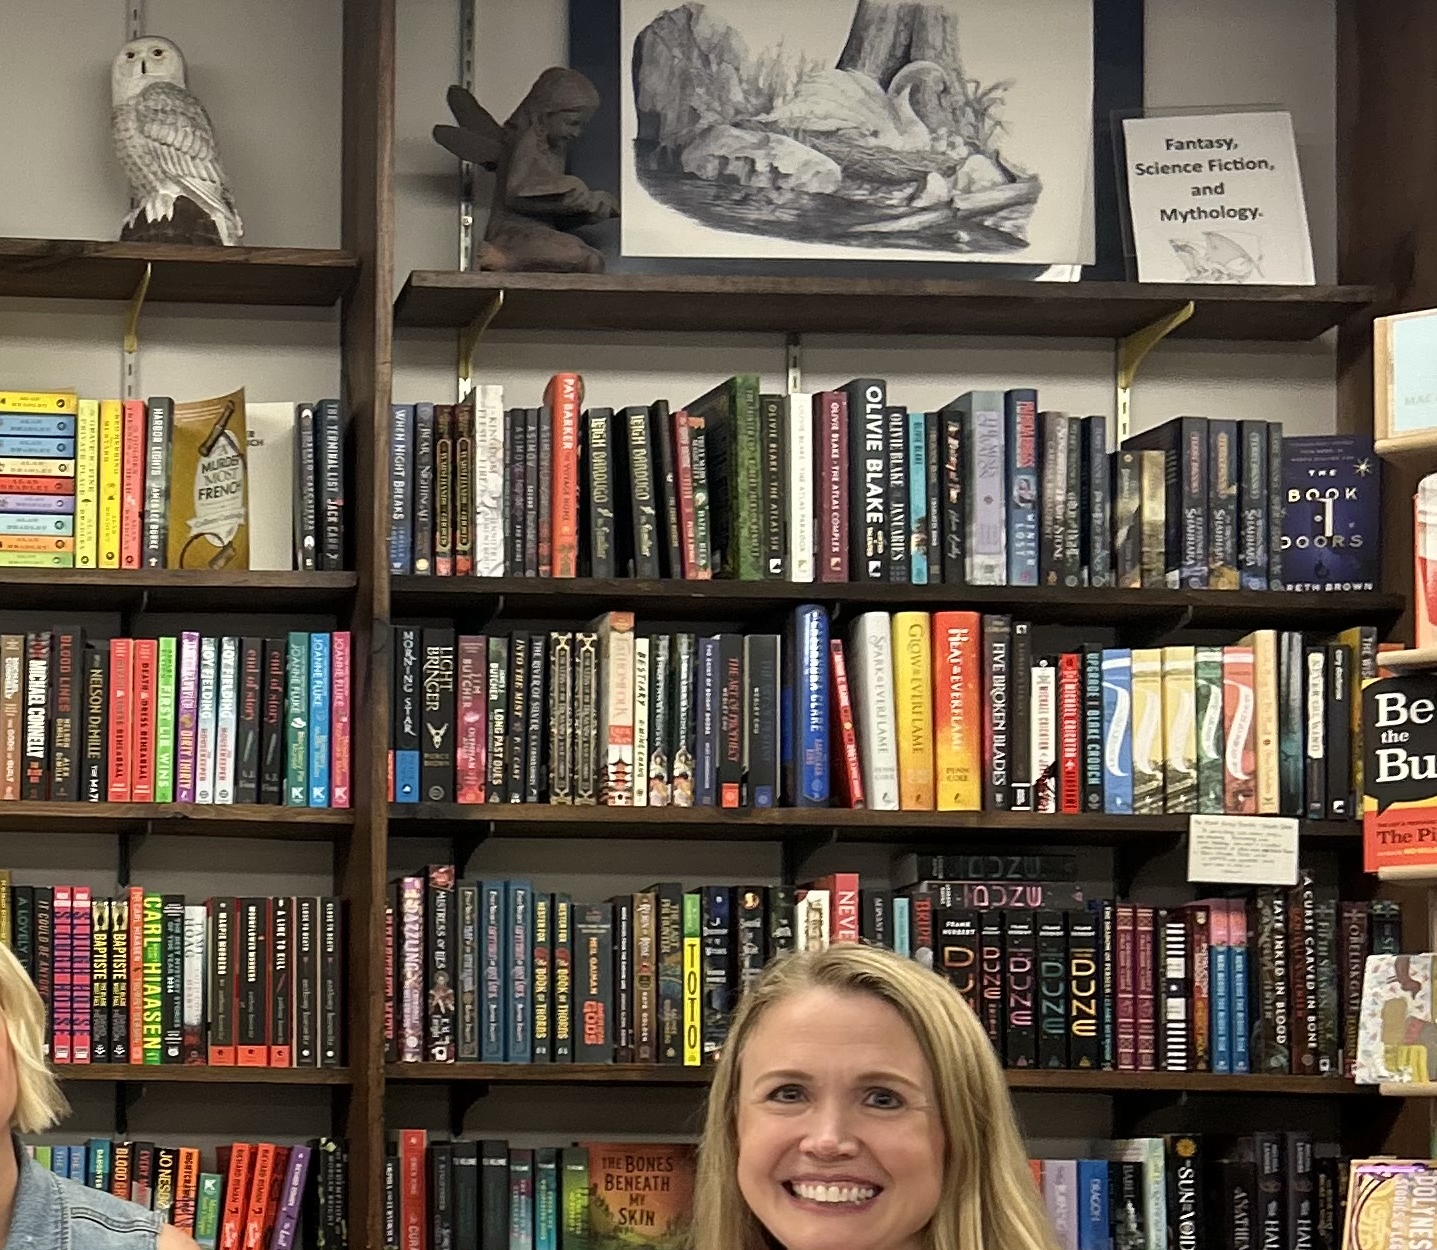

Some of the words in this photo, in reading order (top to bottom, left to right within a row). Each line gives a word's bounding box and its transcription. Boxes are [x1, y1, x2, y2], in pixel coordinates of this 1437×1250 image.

[1165, 138, 1238, 151] Fantasy,
[1135, 161, 1202, 176] Science
[1208, 158, 1275, 172] Fiction,
[1191, 182, 1224, 196] and
[1160, 206, 1263, 223] Mythology.
[562, 378, 574, 399] PAT
[393, 410, 405, 441] WHEN
[561, 402, 574, 449] BARKER
[865, 386, 883, 455] OLIVIE
[888, 413, 903, 454] OLIVIE
[392, 445, 405, 477] NIGHT
[889, 457, 904, 487] BLAKE
[1308, 469, 1337, 477] THE
[392, 480, 406, 519] BREAKS
[865, 459, 883, 524] BLAKE
[1288, 488, 1357, 502] BOOK
[889, 502, 905, 562] JANUARIES
[59, 635, 72, 673] BLOOD
[438, 646, 453, 692] LIGHT
[992, 643, 1006, 672] FIVE
[59, 677, 71, 711] LINES
[89, 669, 103, 712] NELSON
[422, 646, 440, 711] BRINGER
[159, 685, 171, 722] FIRST
[989, 675, 1006, 731] BROKEN
[1374, 692, 1435, 727] Be
[88, 715, 102, 759] DeMILLE
[158, 726, 171, 748] LIE
[1381, 729, 1409, 744] the
[158, 753, 171, 787] WINS
[992, 735, 1006, 786] BLADES
[1377, 831, 1413, 845] The
[143, 897, 161, 946] CARL
[112, 933, 127, 979] BAPTISTE
[589, 937, 598, 955] NEIL
[589, 957, 598, 995] GAIMAN
[143, 963, 162, 1050] HIAASEN
[605, 1174, 670, 1192] BENEATH
[1178, 1167, 1194, 1202] SUN
[619, 1208, 655, 1226] SKIN
